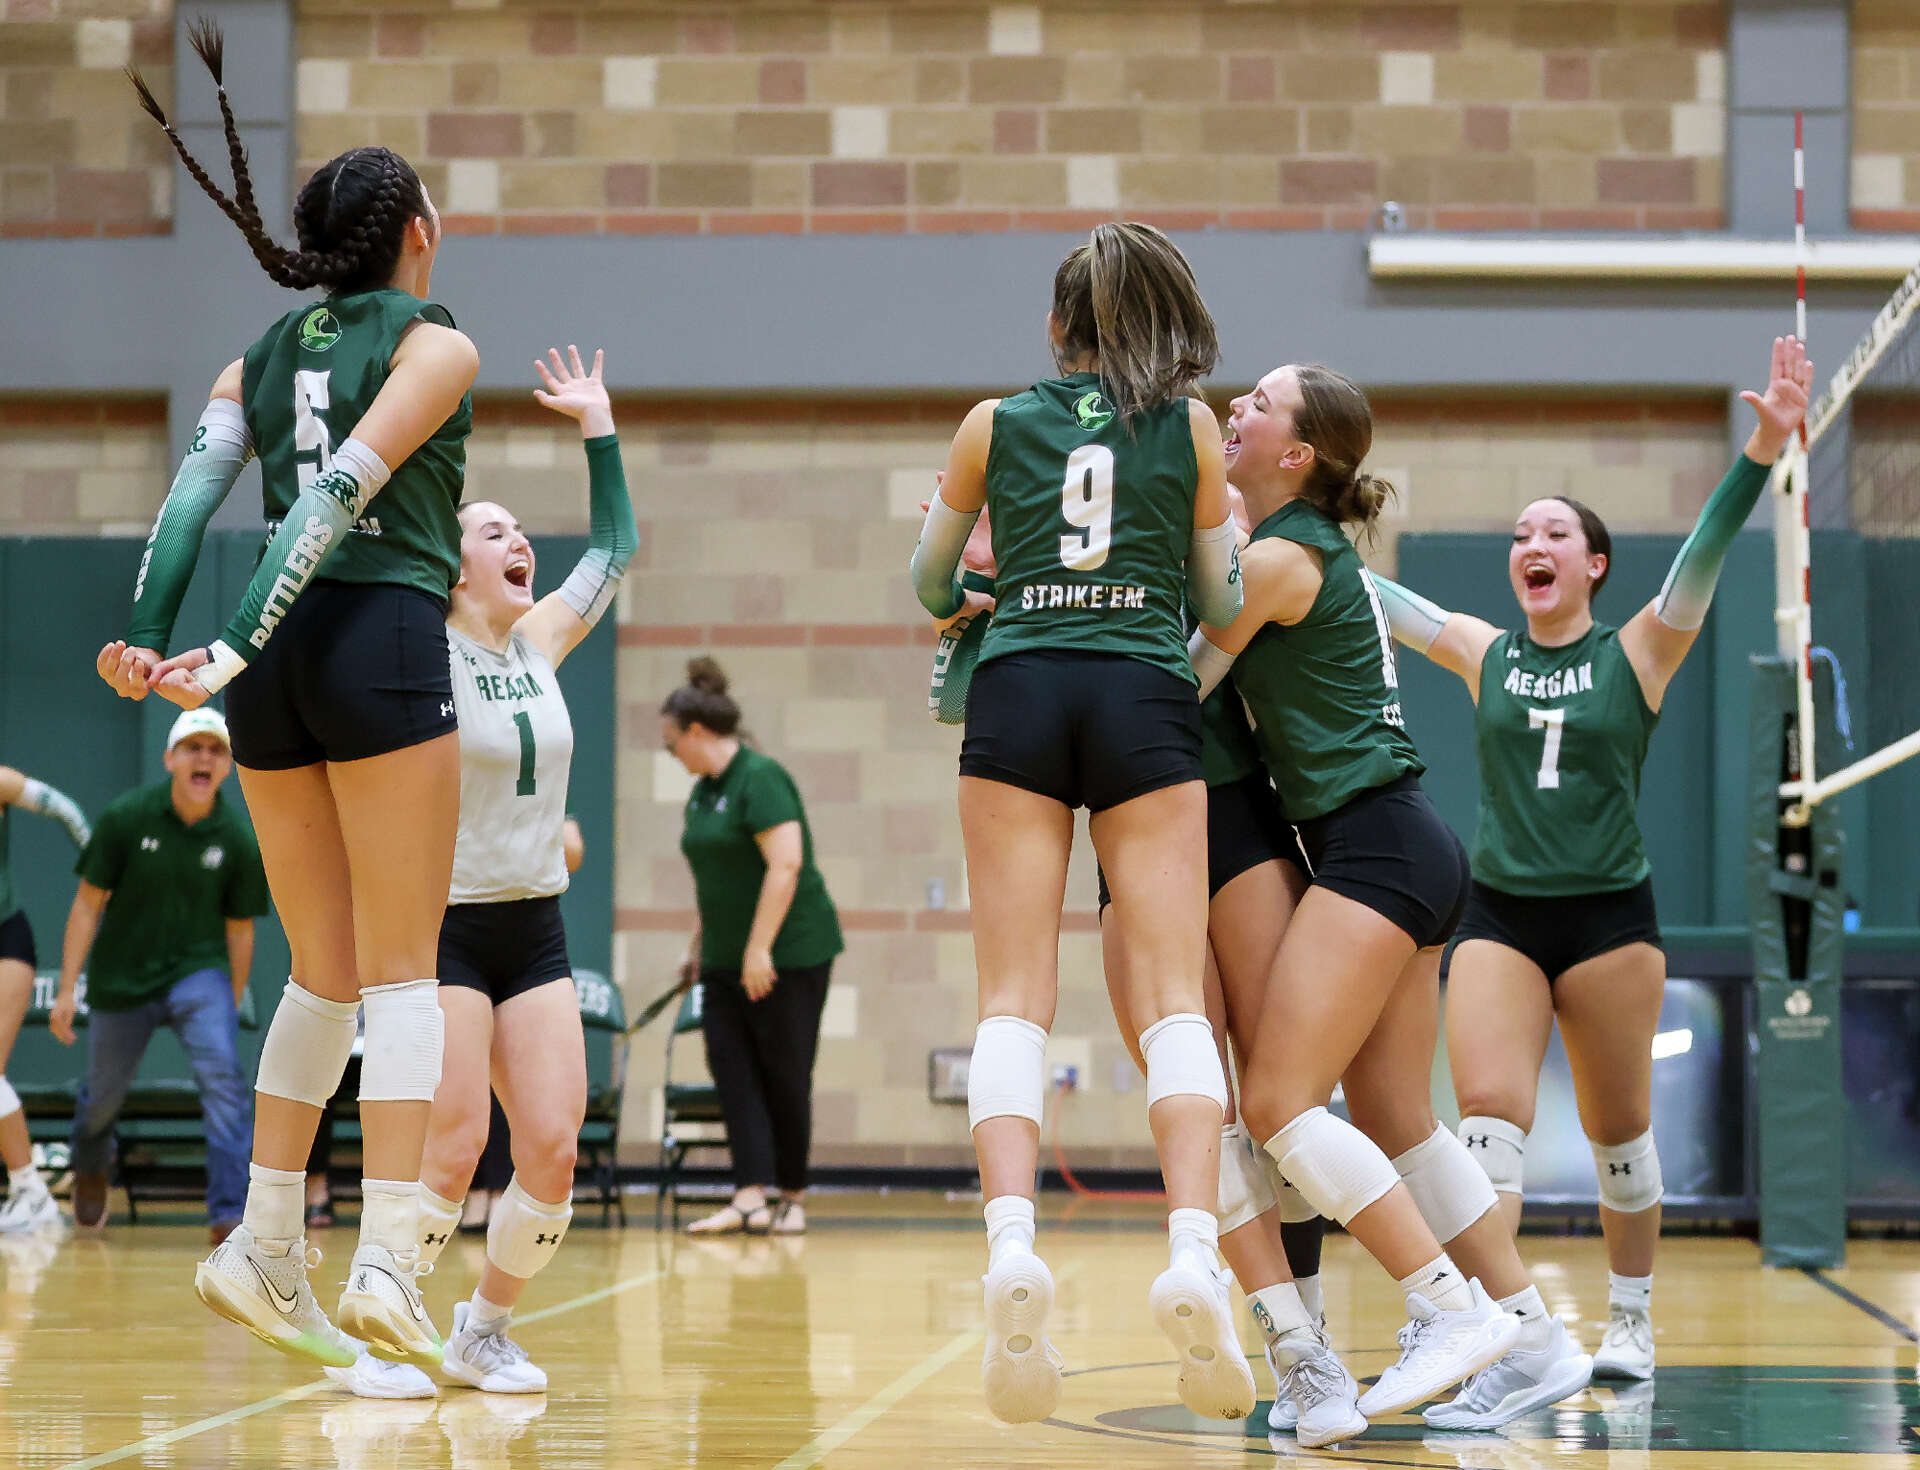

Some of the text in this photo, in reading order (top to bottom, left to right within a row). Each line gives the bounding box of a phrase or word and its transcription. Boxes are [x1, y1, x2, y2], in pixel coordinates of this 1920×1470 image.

[295, 369, 334, 498] 5
[1059, 443, 1115, 572] 9
[249, 515, 335, 651] RATTLERS
[1021, 584, 1146, 610] STRIKE'EM
[1503, 661, 1594, 700] REAGAN
[513, 710, 537, 797] 1
[1528, 707, 1565, 789] 7
